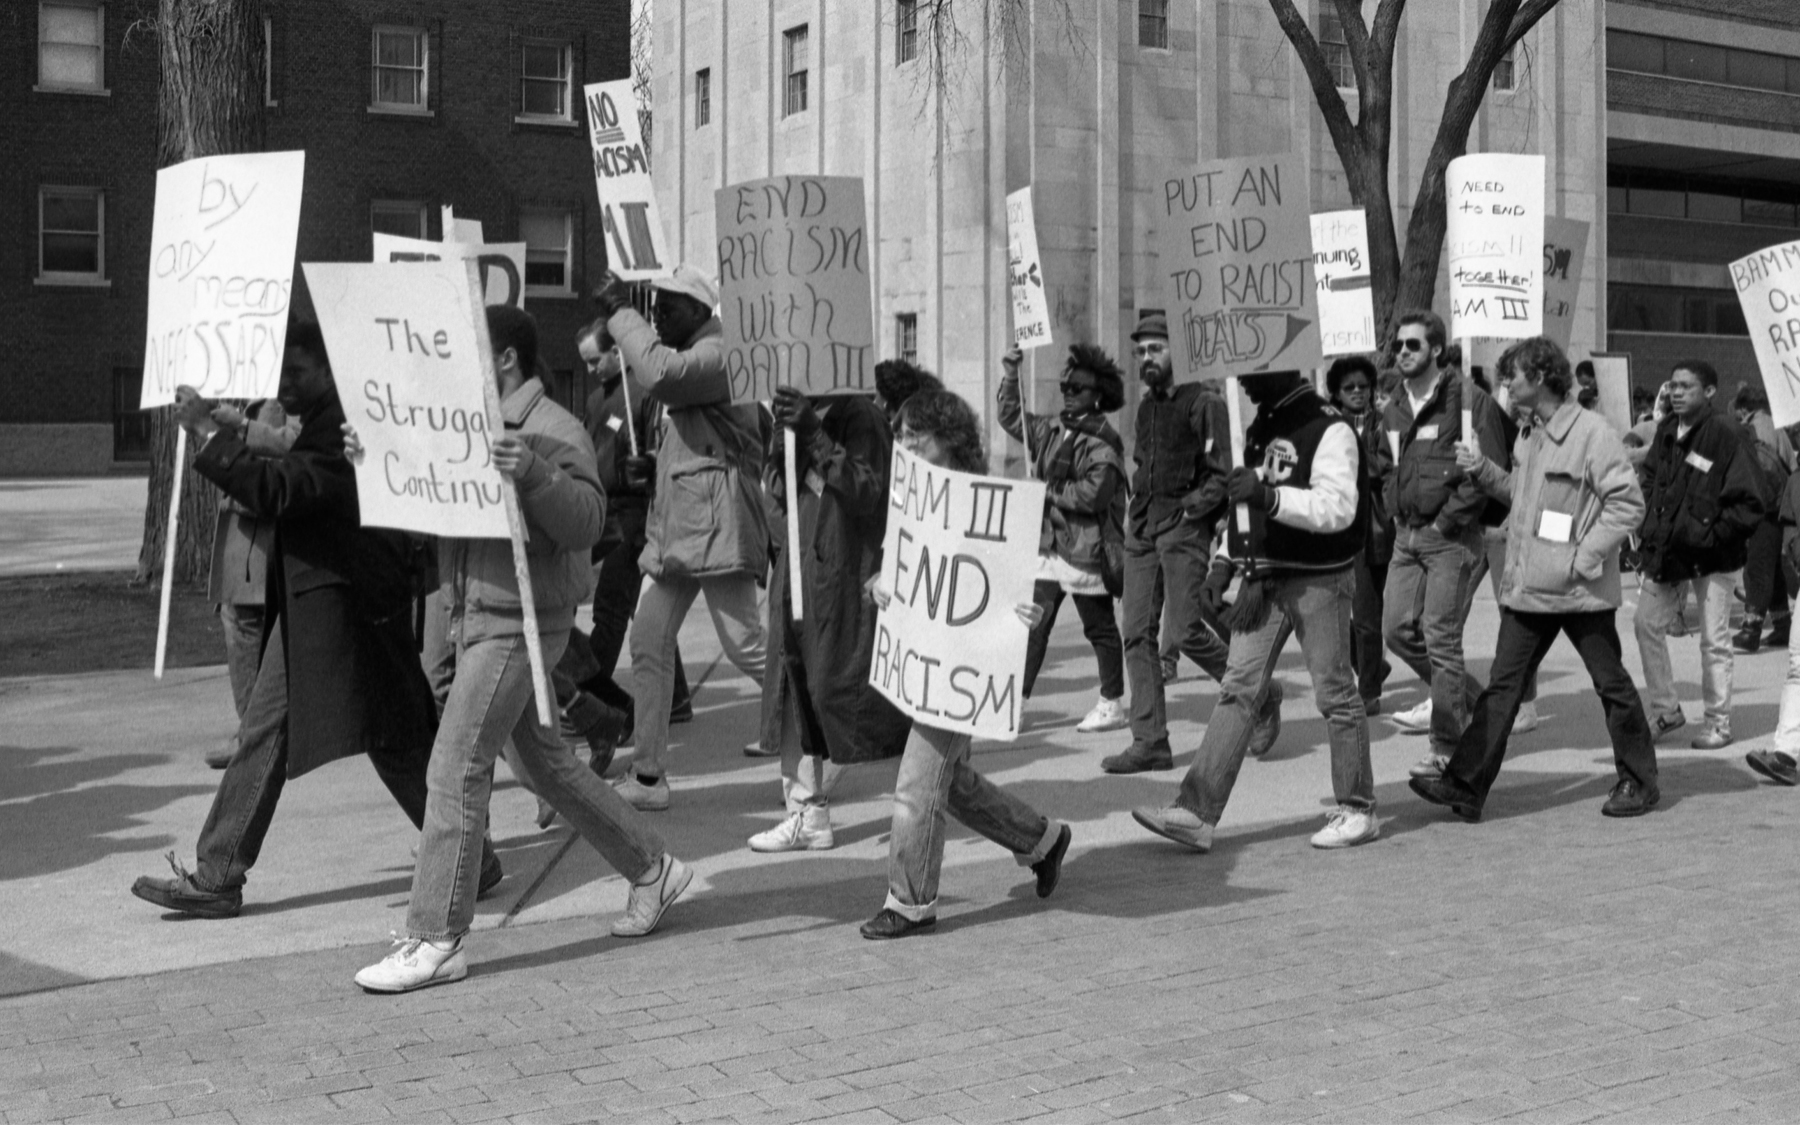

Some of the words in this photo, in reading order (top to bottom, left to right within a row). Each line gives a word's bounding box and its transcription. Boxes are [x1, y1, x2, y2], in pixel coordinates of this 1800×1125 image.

[588, 91, 619, 131] NO
[594, 143, 648, 178] ACISM
[199, 162, 259, 231] by
[736, 175, 827, 225] END
[1165, 170, 1223, 216] PUT
[1231, 164, 1281, 207] AN
[1461, 181, 1504, 195] NEED
[1492, 204, 1525, 216] END
[1191, 217, 1266, 258] END
[155, 239, 216, 282] any
[1170, 268, 1202, 301] TO
[1220, 258, 1312, 306] RACIST
[1316, 273, 1332, 290] nt
[1543, 244, 1571, 280] SM
[193, 276, 291, 319] means
[1453, 298, 1488, 318] AM
[1494, 296, 1530, 321] III
[374, 317, 452, 360] The
[1016, 321, 1044, 342] ERENCE
[727, 341, 813, 401] BAM
[822, 341, 877, 395] III
[363, 378, 492, 469] Struggl
[384, 450, 502, 510] Continu
[891, 450, 950, 531] BAM
[964, 481, 1013, 543] III
[893, 527, 990, 627] END
[873, 623, 1016, 733] RACISM
